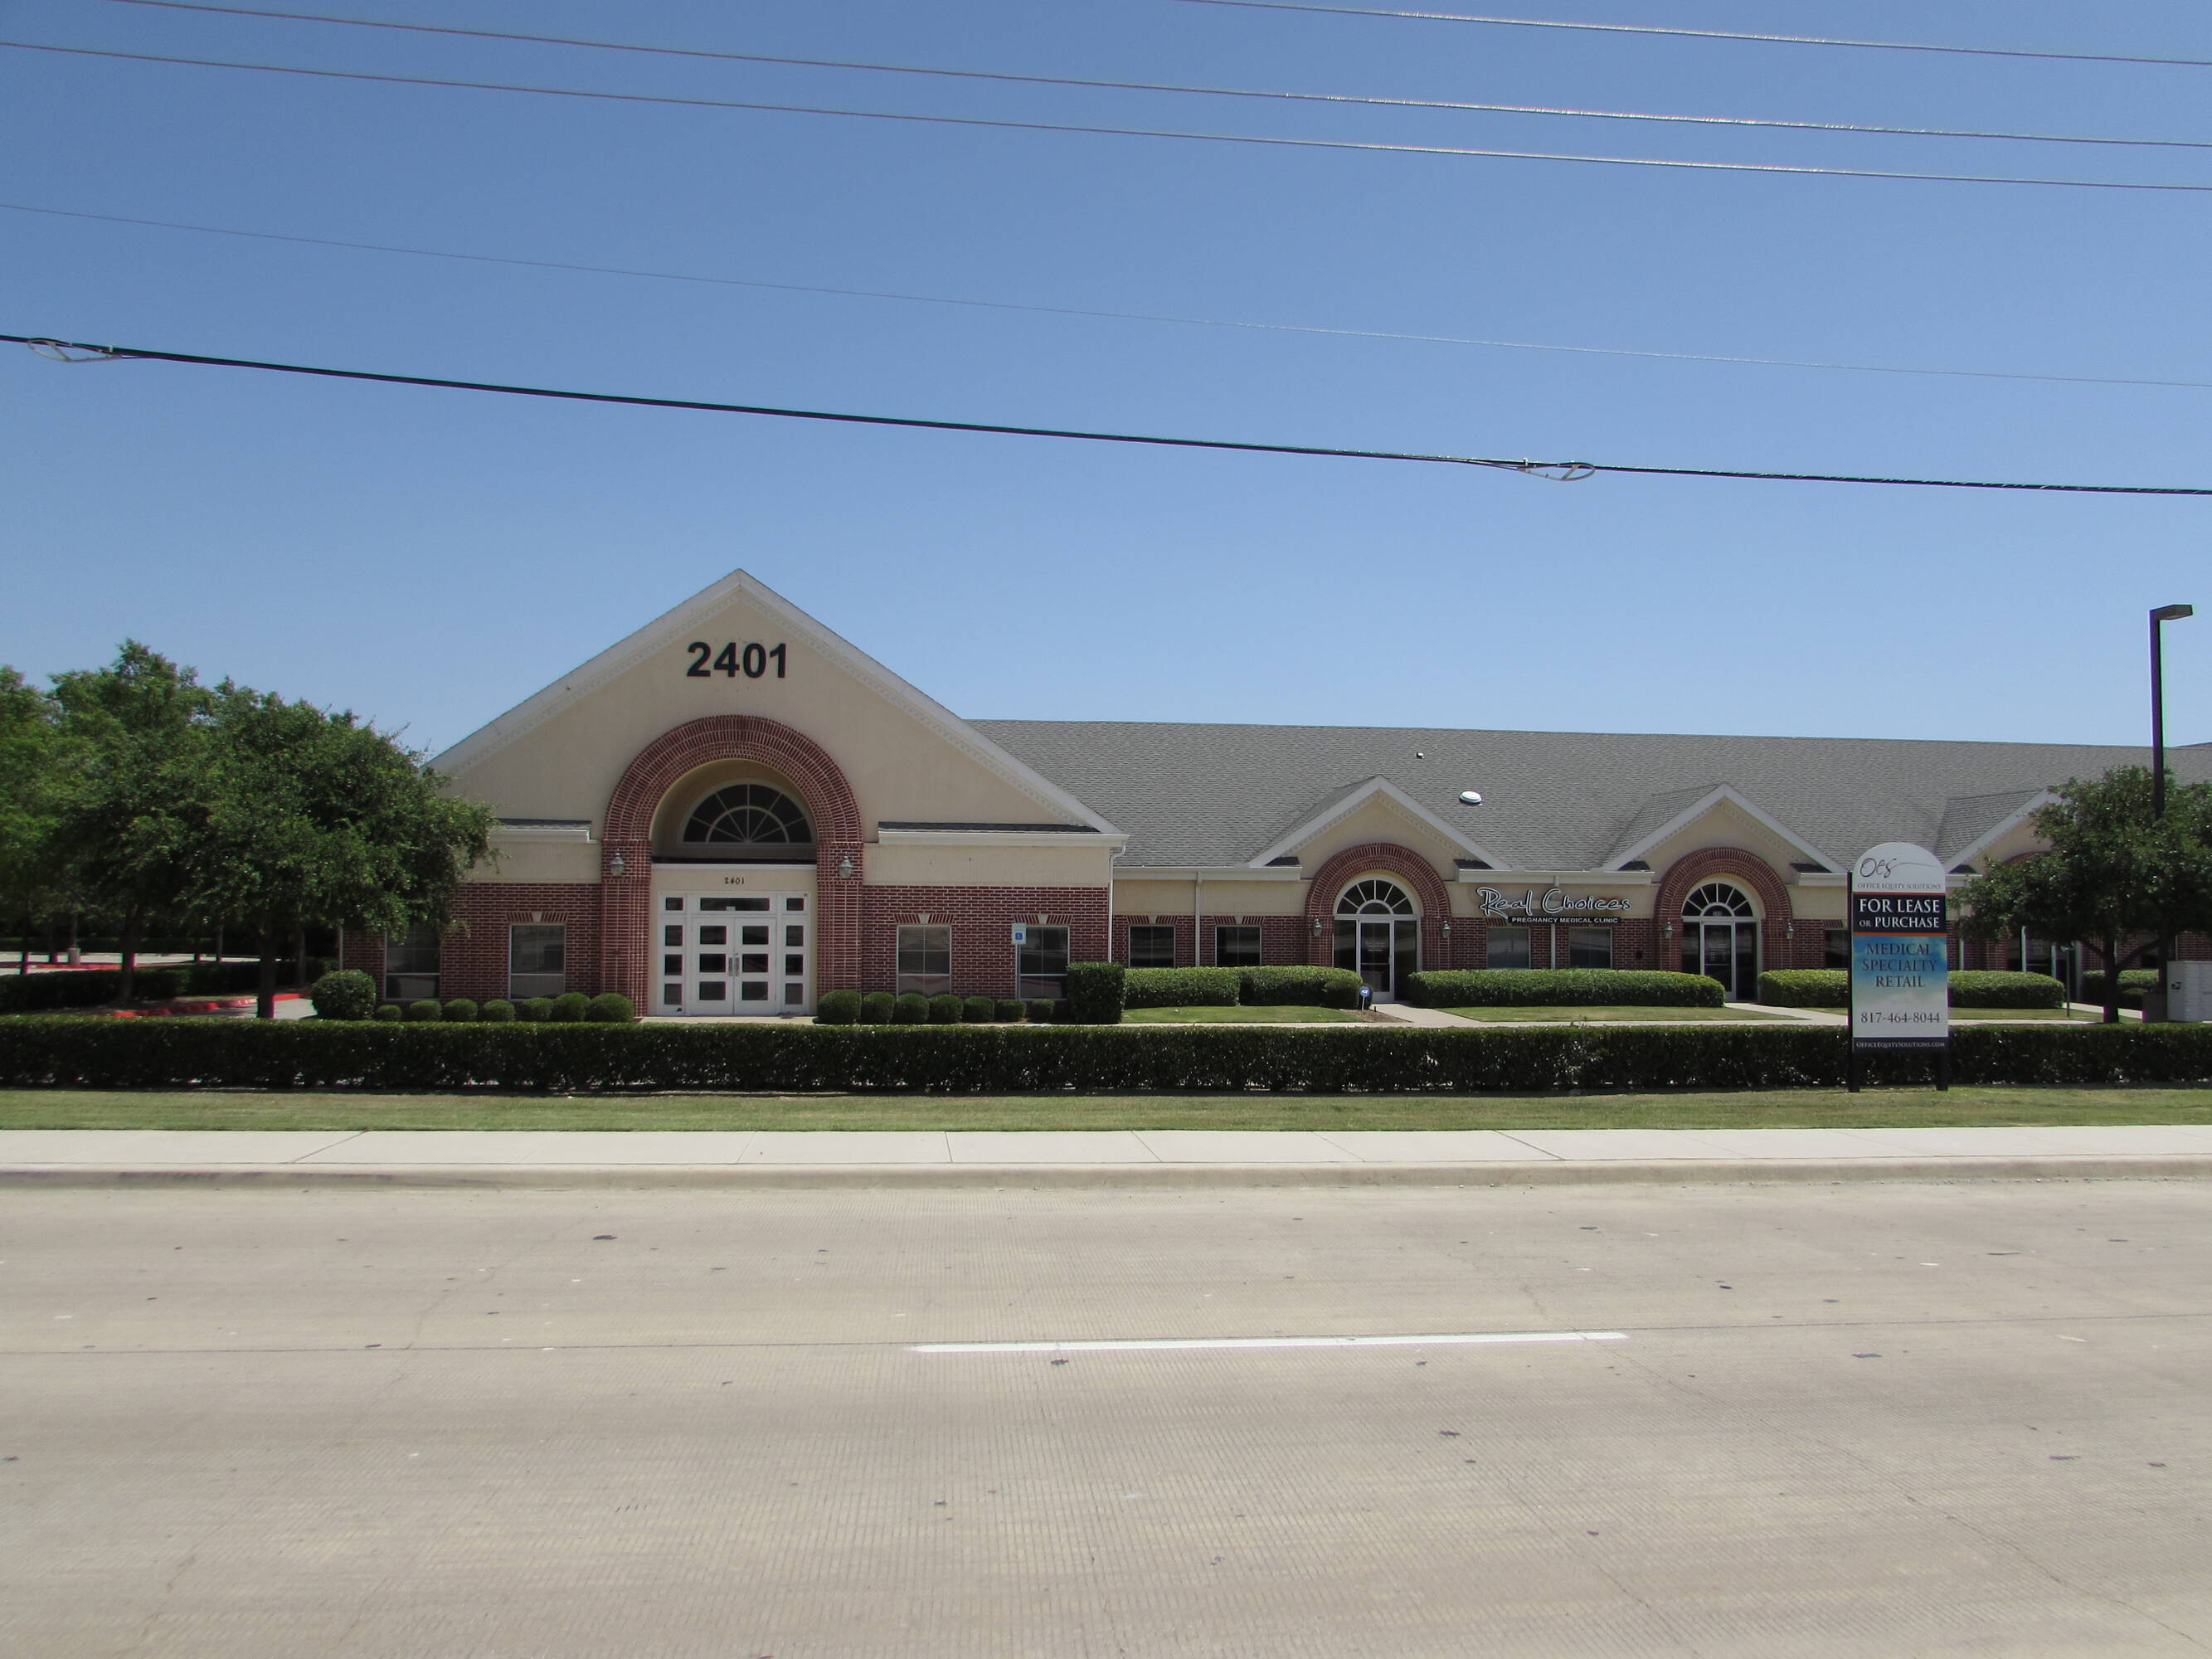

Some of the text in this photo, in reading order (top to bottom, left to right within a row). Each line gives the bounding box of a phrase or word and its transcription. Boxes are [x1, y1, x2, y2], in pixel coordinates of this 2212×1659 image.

[686, 641, 786, 679] 2401
[724, 876, 745, 885] 2401
[1476, 887, 1632, 920] Real Choices
[1859, 898, 1941, 913] FOR LEASE
[1874, 916, 1940, 928] PURCHASE
[1865, 942, 1932, 956] MEDICAL
[1861, 958, 1938, 972] SPECIALTY
[1875, 975, 1926, 988] RETAIL
[1860, 1011, 1941, 1024] 817-464-8044
